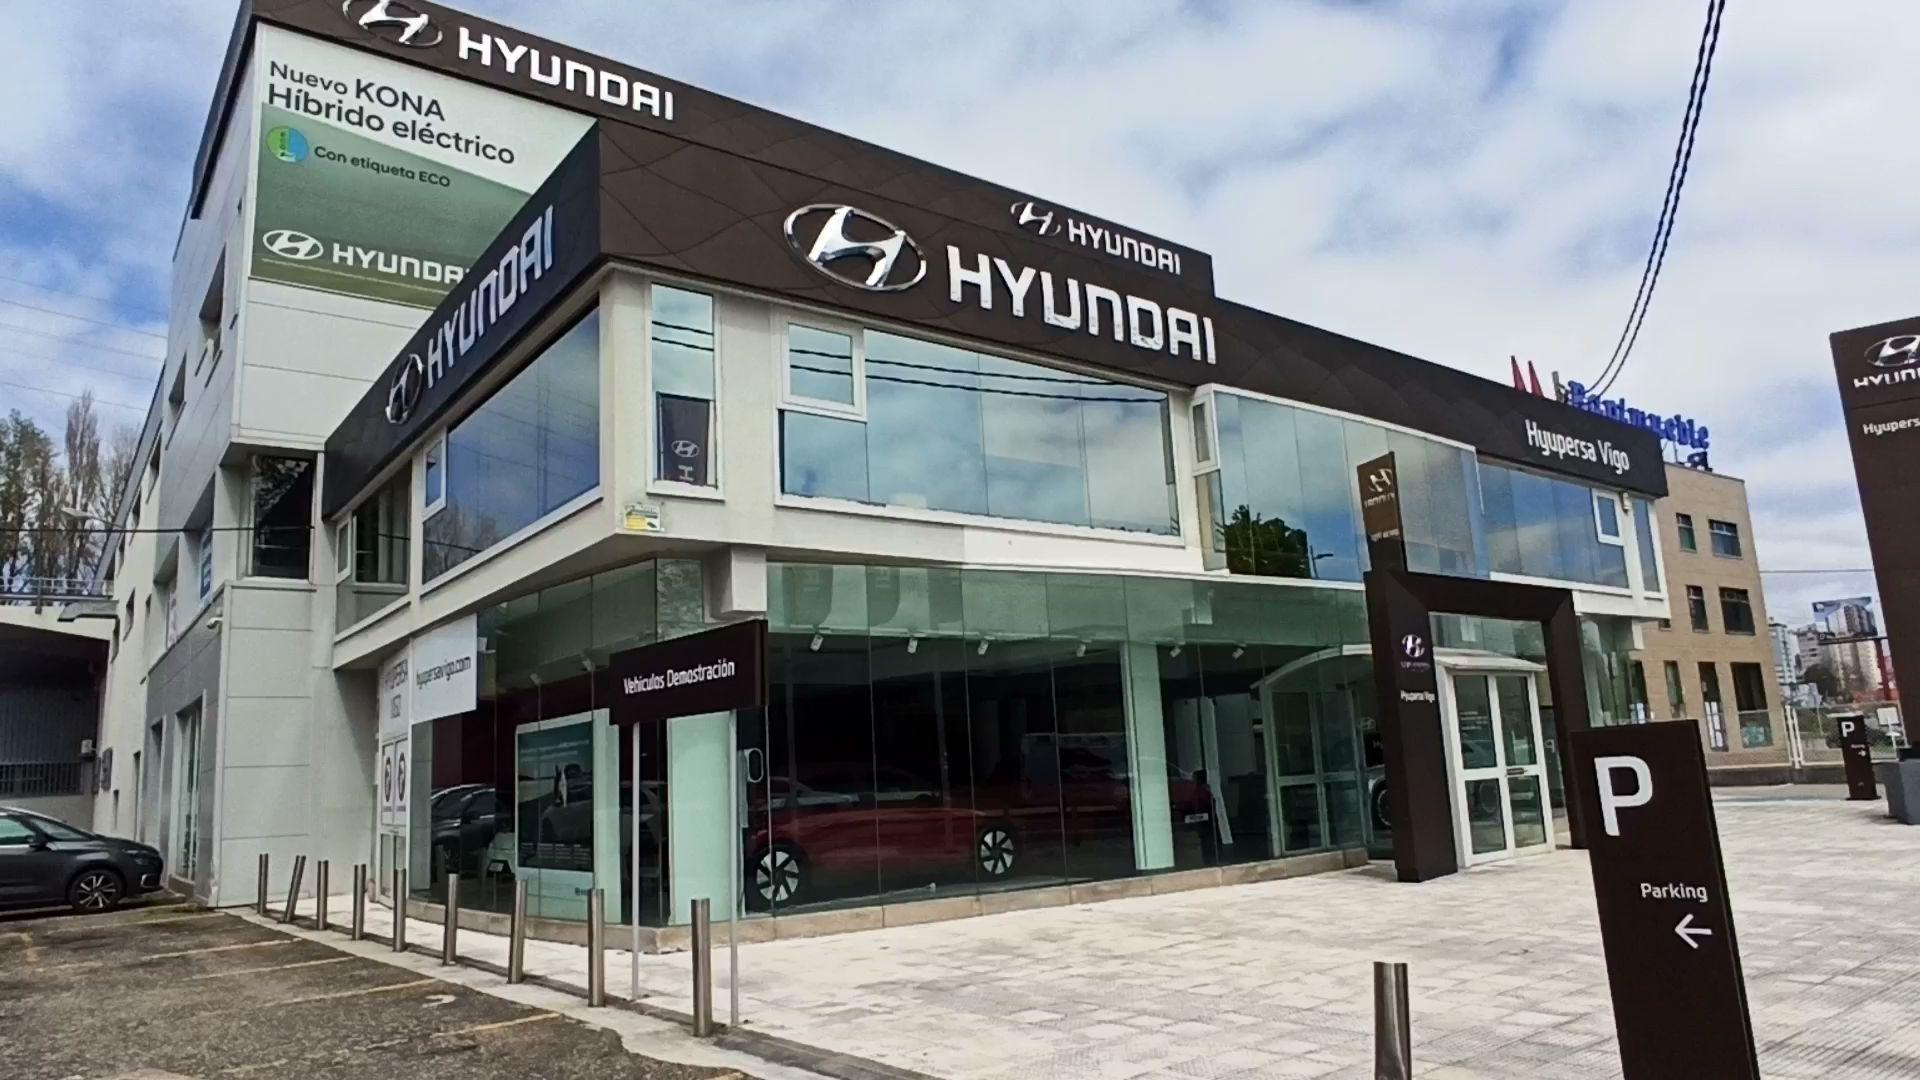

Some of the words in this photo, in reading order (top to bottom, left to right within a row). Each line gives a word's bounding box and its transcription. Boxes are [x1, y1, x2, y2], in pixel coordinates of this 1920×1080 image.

[269, 60, 348, 96] Nuevo
[354, 78, 446, 122] KONA
[458, 26, 675, 121] HYUNDAI
[268, 84, 384, 132] Híbrido
[392, 120, 515, 165] eléctrico
[314, 145, 347, 165] Con
[350, 157, 416, 181] etiqueta
[418, 171, 451, 188] ECO
[332, 242, 470, 285] HYUNDA
[1067, 218, 1182, 275] HYUNDAI
[427, 204, 554, 388] HYUNDAI
[946, 245, 1217, 365] HYUNDAI
[1525, 419, 1598, 460] Hyupersa
[1597, 440, 1631, 475] Vigo
[666, 658, 735, 687] Demostración
[1841, 721, 1855, 738] P
[1593, 755, 1653, 837] P
[1640, 882, 1709, 903] Parking
